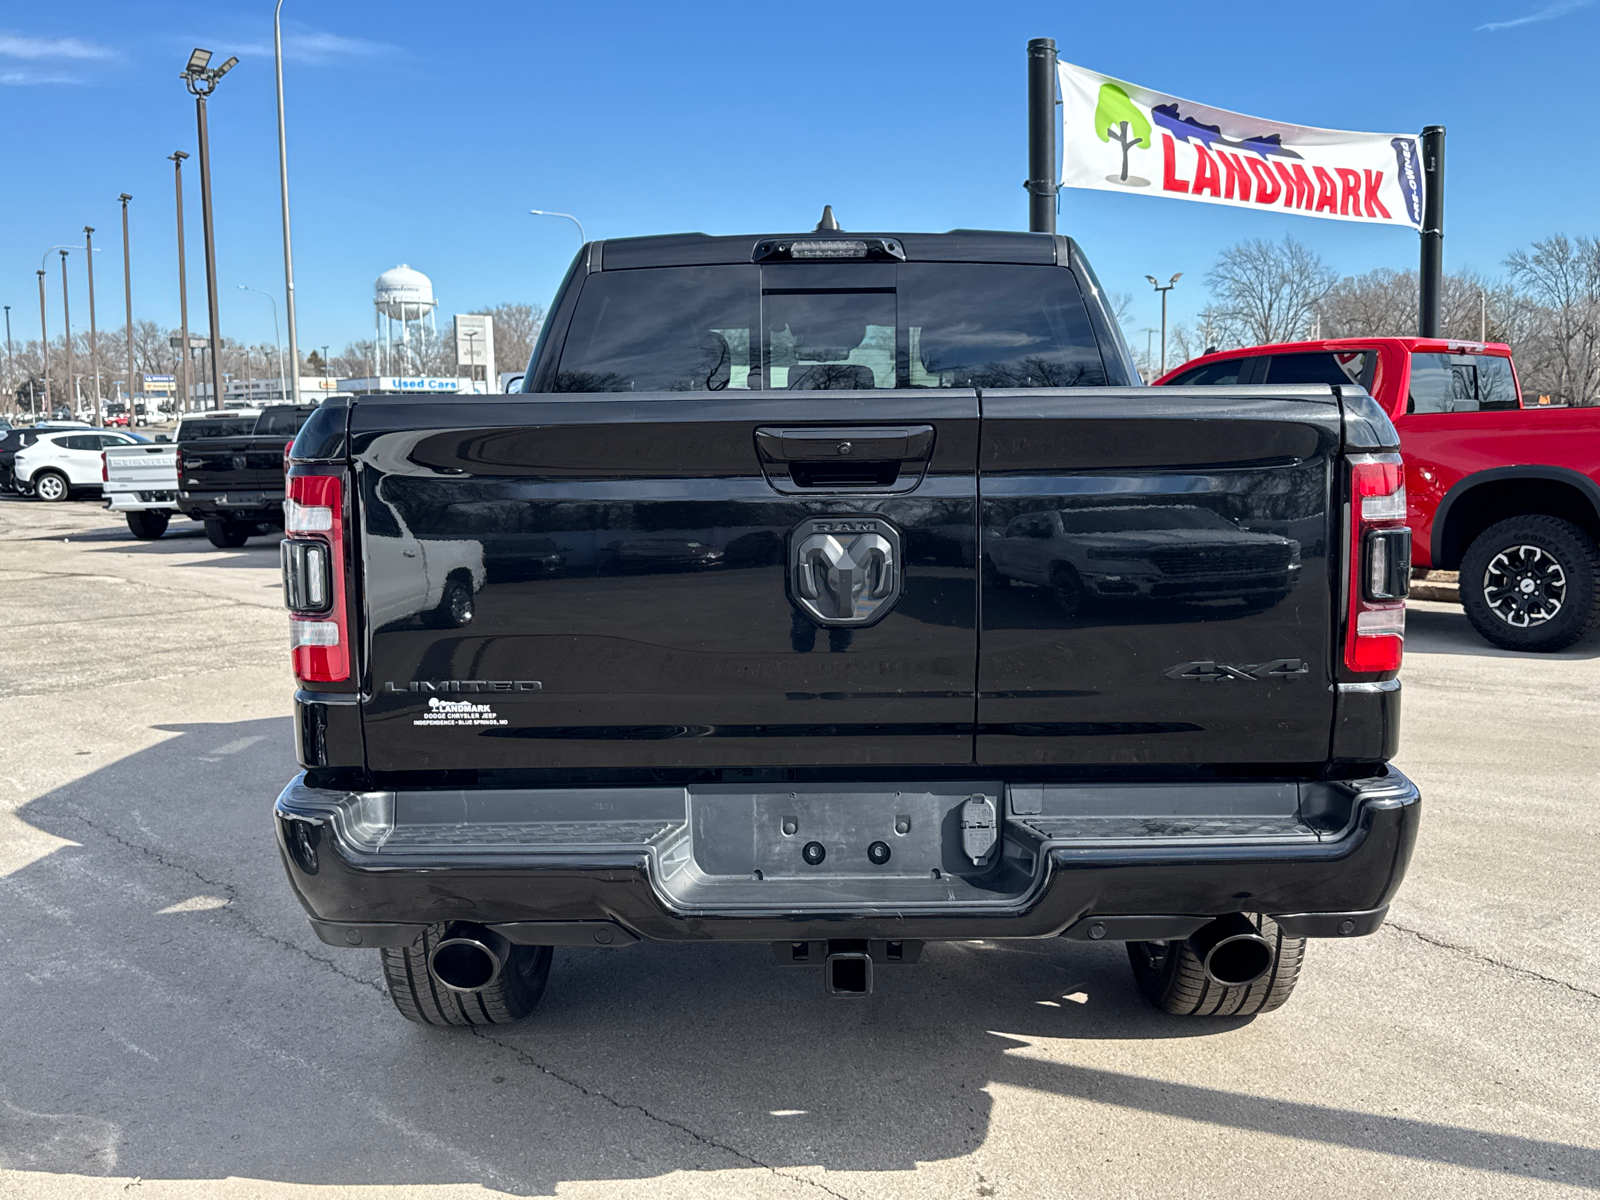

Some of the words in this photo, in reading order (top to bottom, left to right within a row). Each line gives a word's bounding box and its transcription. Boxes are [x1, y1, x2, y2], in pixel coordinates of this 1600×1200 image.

[1161, 132, 1393, 220] LANDMARK
[1400, 141, 1420, 222] PRE-OWNED
[392, 378, 425, 388] Used
[428, 379, 457, 389] Cars
[812, 521, 878, 532] RAM
[384, 680, 543, 692] LIMITED
[439, 704, 492, 713] LANDMARK
